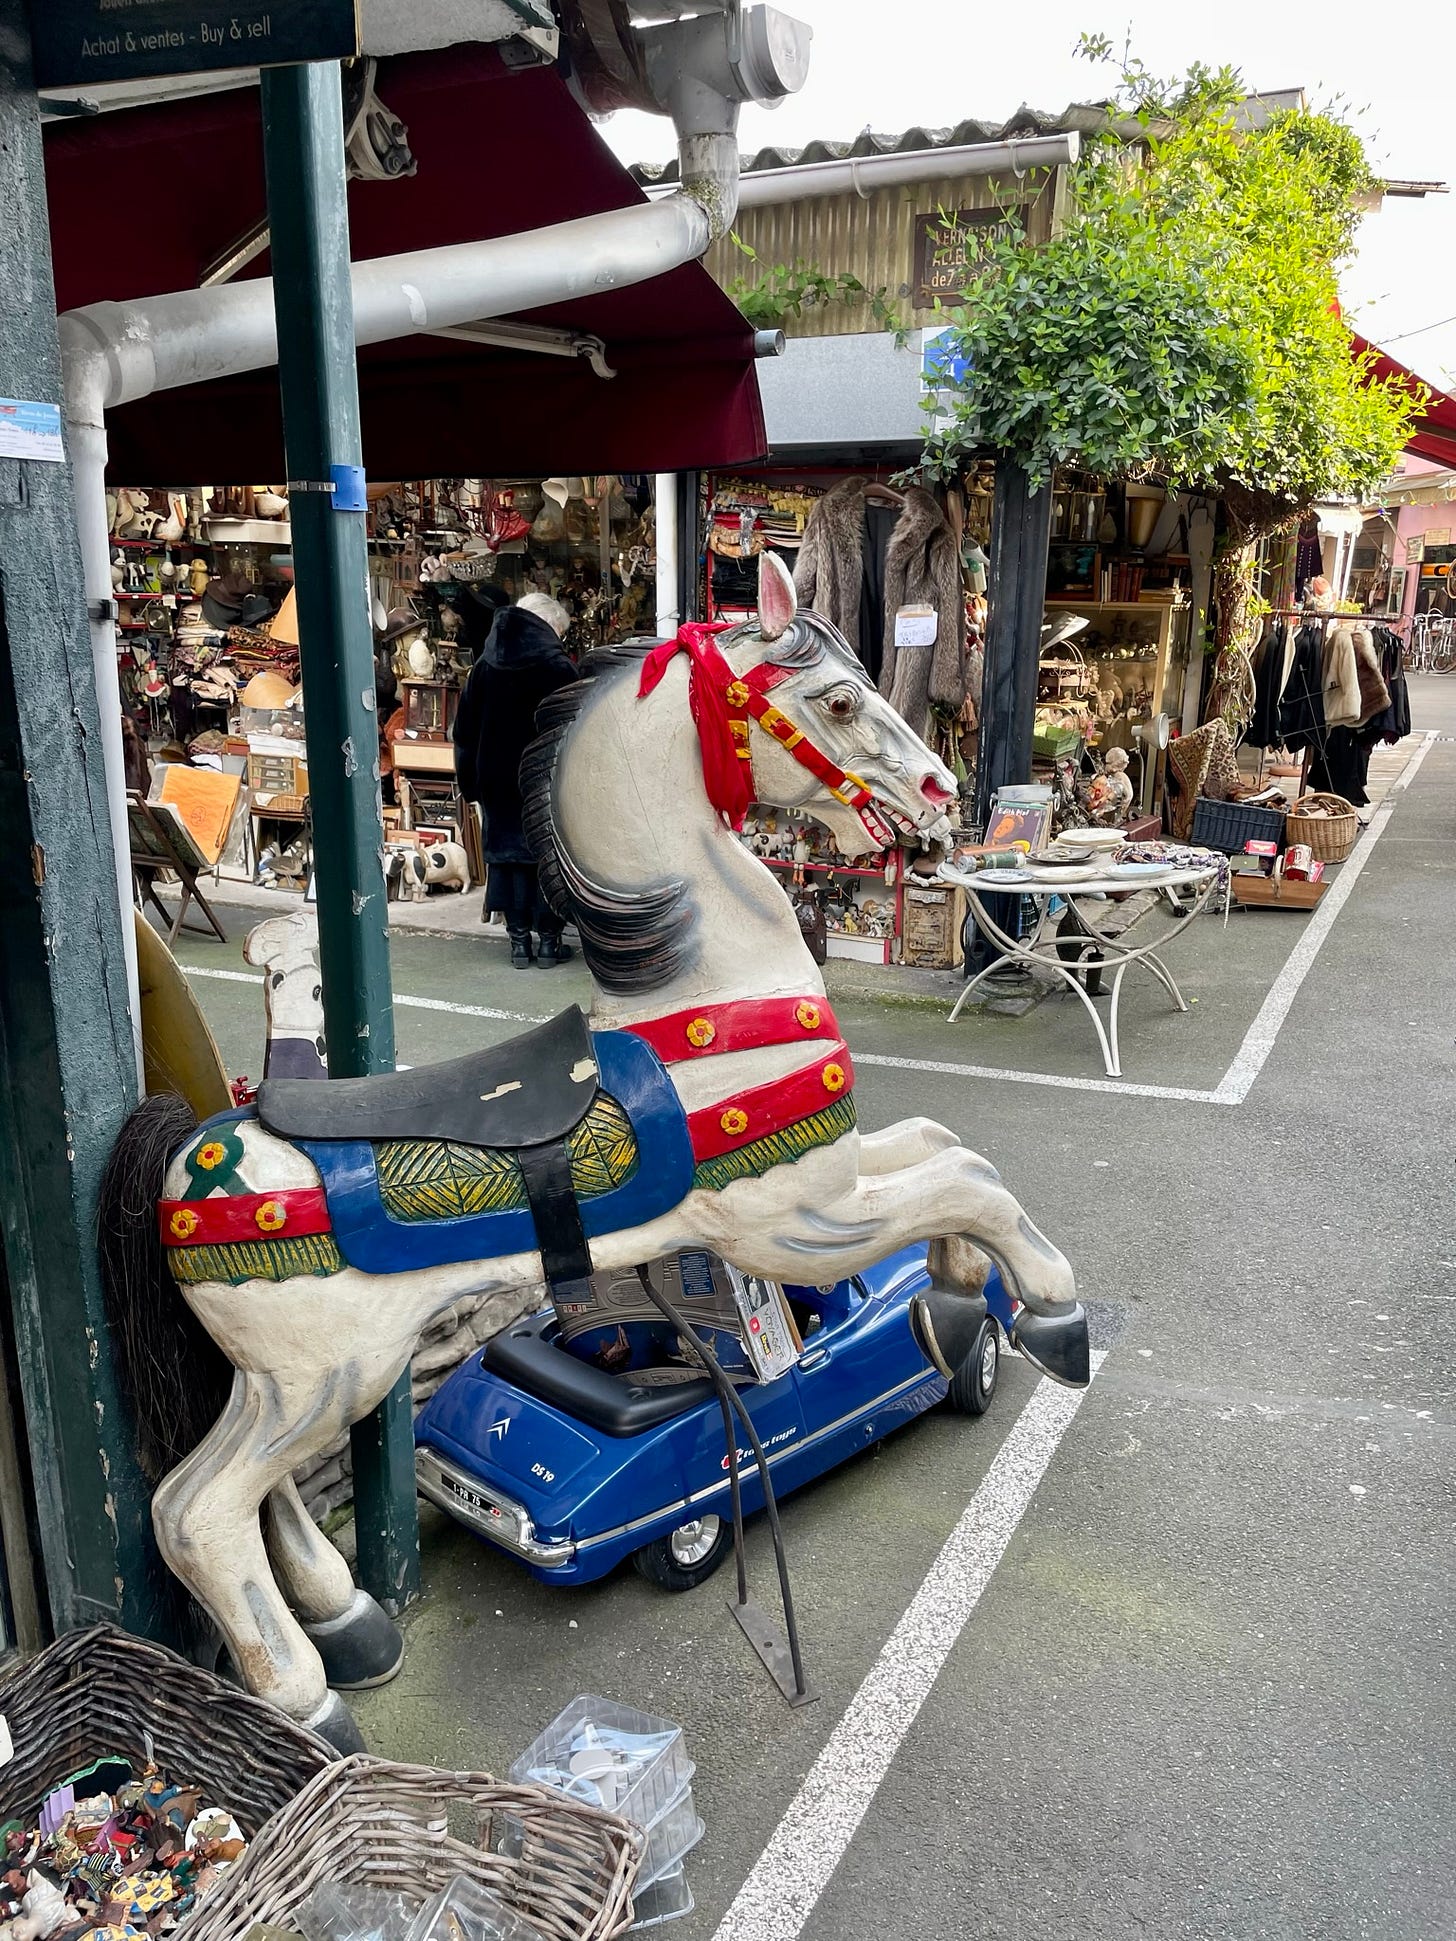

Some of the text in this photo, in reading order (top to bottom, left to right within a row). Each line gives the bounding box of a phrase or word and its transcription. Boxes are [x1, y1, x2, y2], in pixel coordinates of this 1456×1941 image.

[81, 36, 120, 57] Achat
[125, 32, 137, 51] &
[140, 30, 185, 49] ventes
[200, 22, 225, 46] Buy
[229, 19, 242, 40] &
[247, 15, 271, 38] sell
[530, 1462, 555, 1483] DS 19
[471, 1494, 481, 1506] 75
